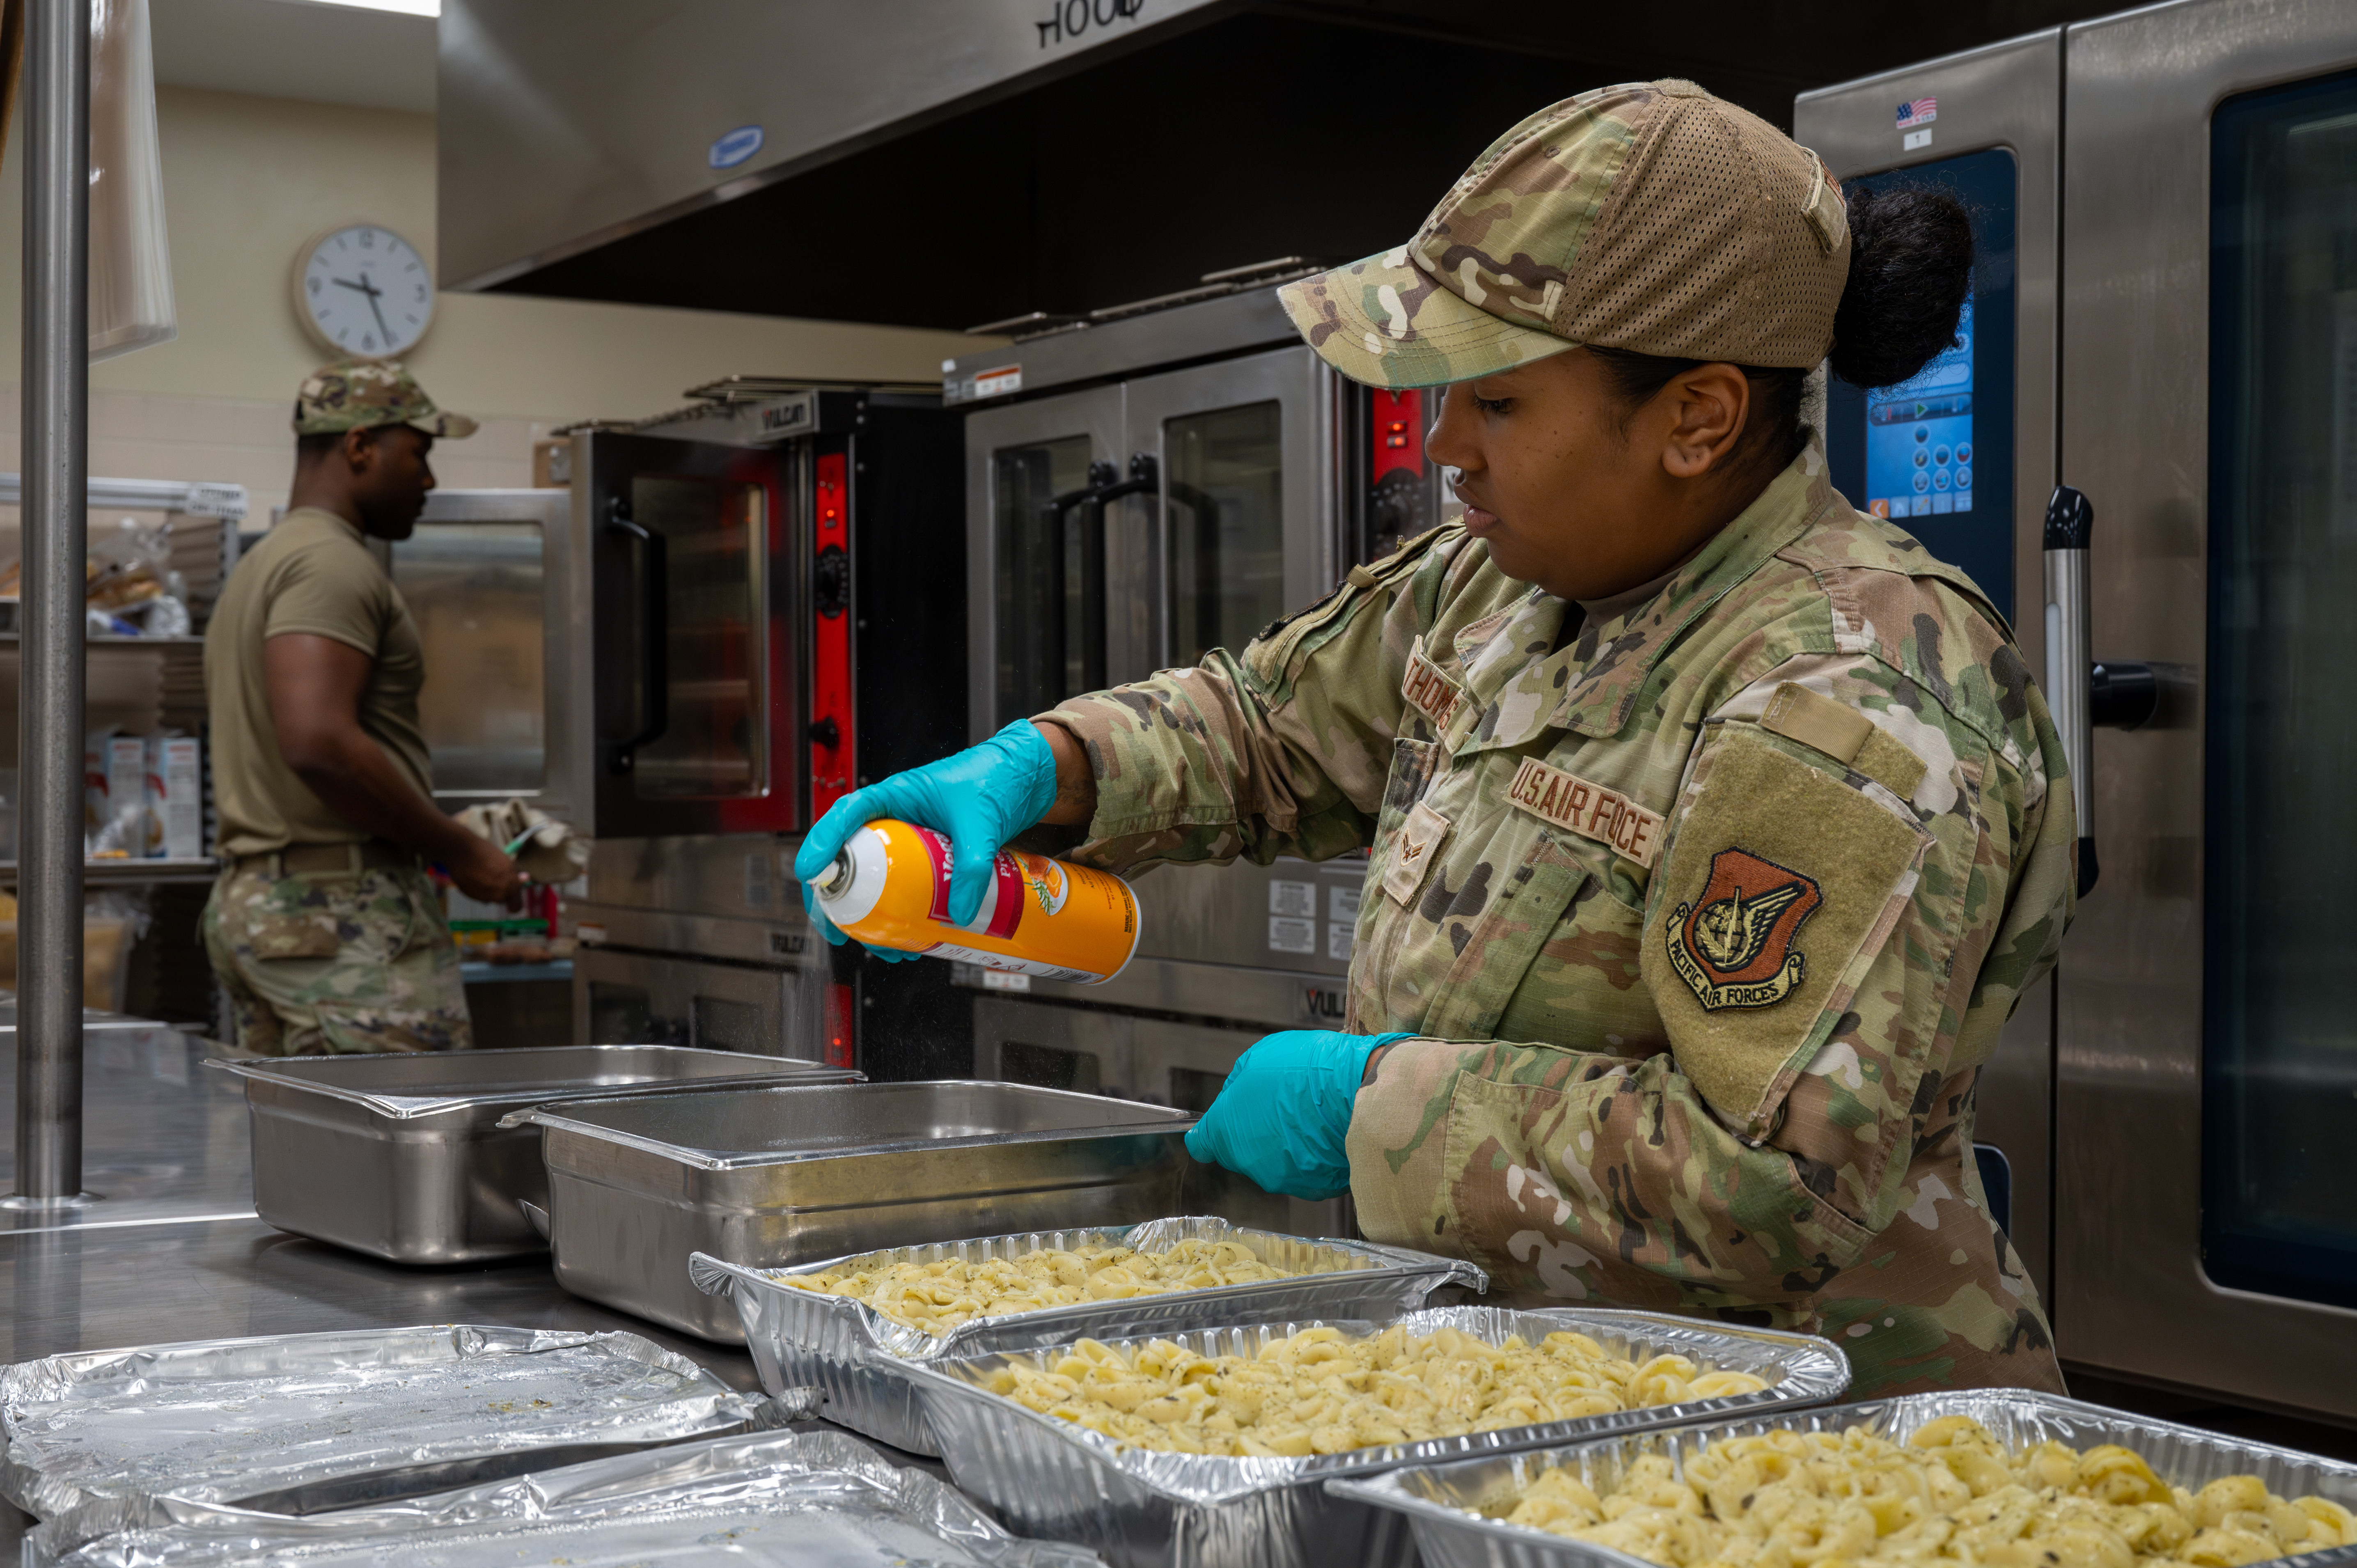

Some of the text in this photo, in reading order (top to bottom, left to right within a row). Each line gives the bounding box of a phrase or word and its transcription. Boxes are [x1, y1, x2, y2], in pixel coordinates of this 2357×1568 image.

[1588, 792, 1652, 858] FOCE
[996, 852, 1011, 878] Pre
[1670, 938, 1779, 1005] PACIFIC AIR FORCES
